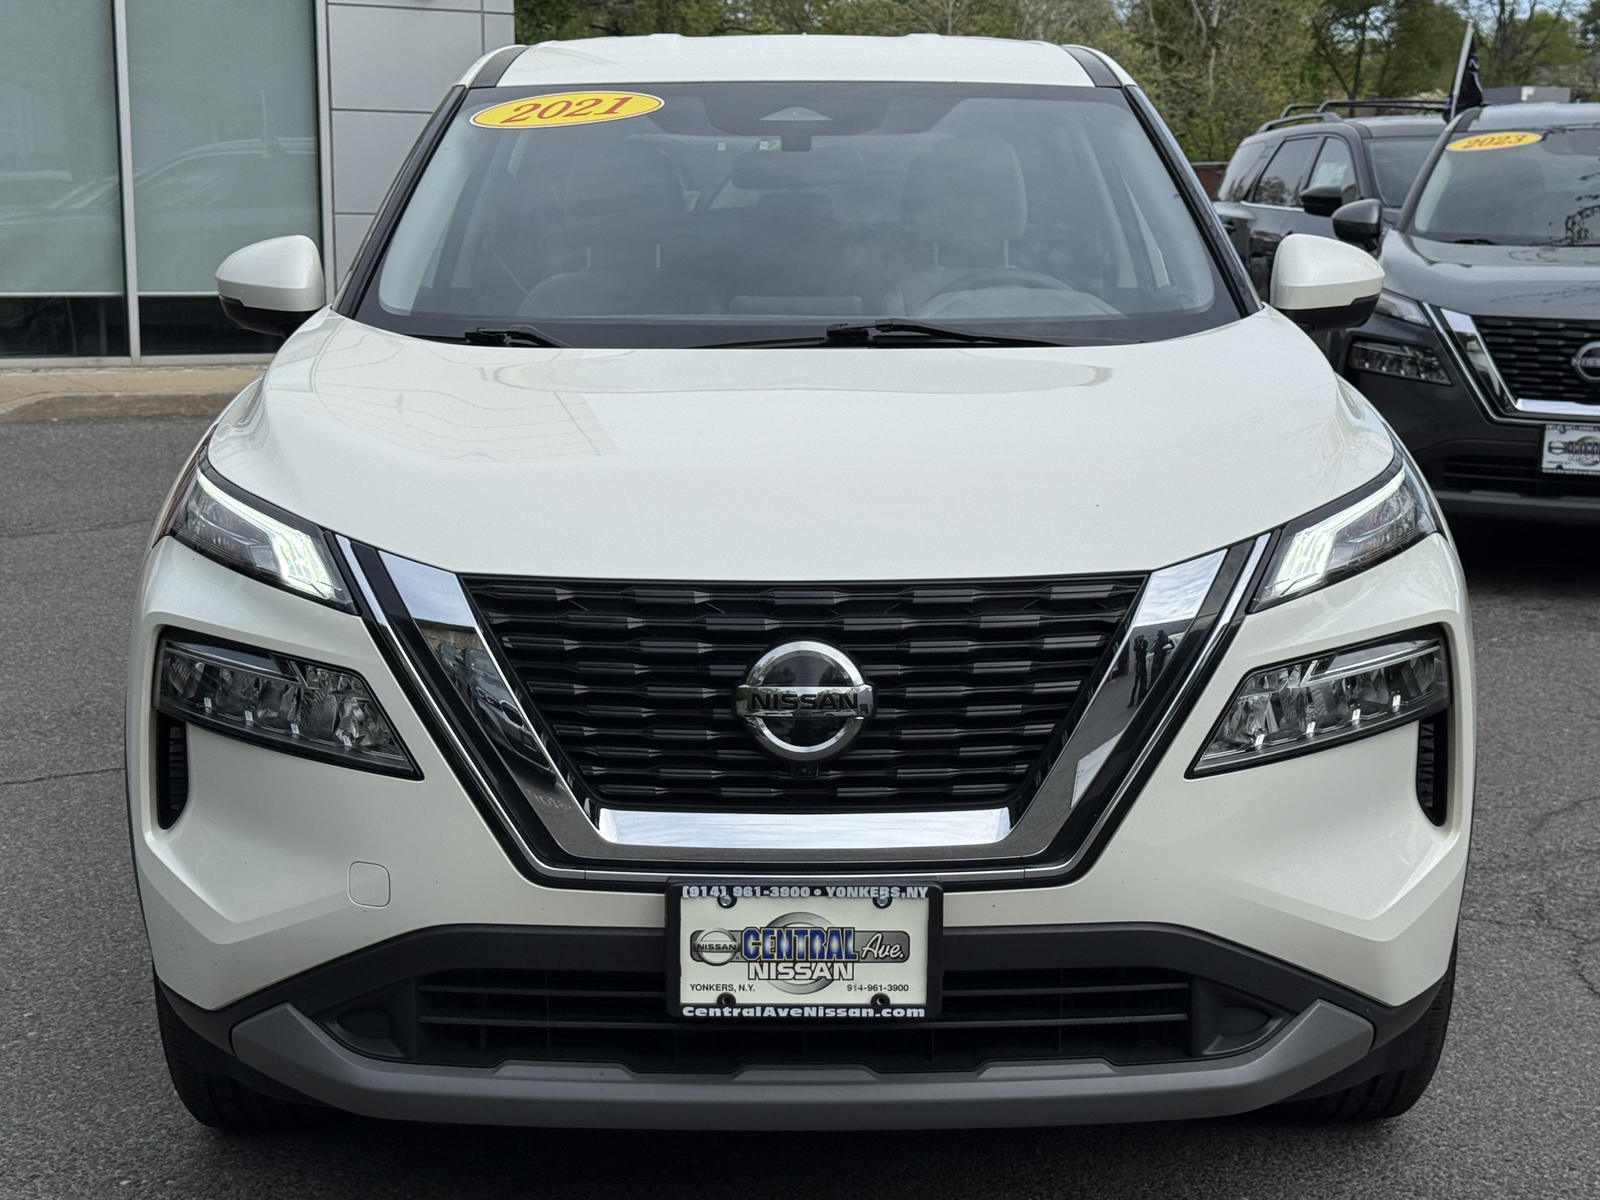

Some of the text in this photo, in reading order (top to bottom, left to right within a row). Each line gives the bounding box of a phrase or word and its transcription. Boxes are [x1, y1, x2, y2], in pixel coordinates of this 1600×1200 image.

[500, 97, 634, 124] 2021
[1462, 135, 1526, 149] 2023
[752, 693, 858, 710] NISSAN
[732, 886, 810, 898] 961-3900
[696, 943, 737, 951] NISSAN
[741, 927, 904, 962] CENTRAL Ave.
[748, 961, 854, 980] NISSAN
[690, 984, 755, 993] YONKERS, N.Y.
[846, 984, 909, 992] 914-961-3900
[682, 1006, 925, 1018] CentralAveNissan.com
